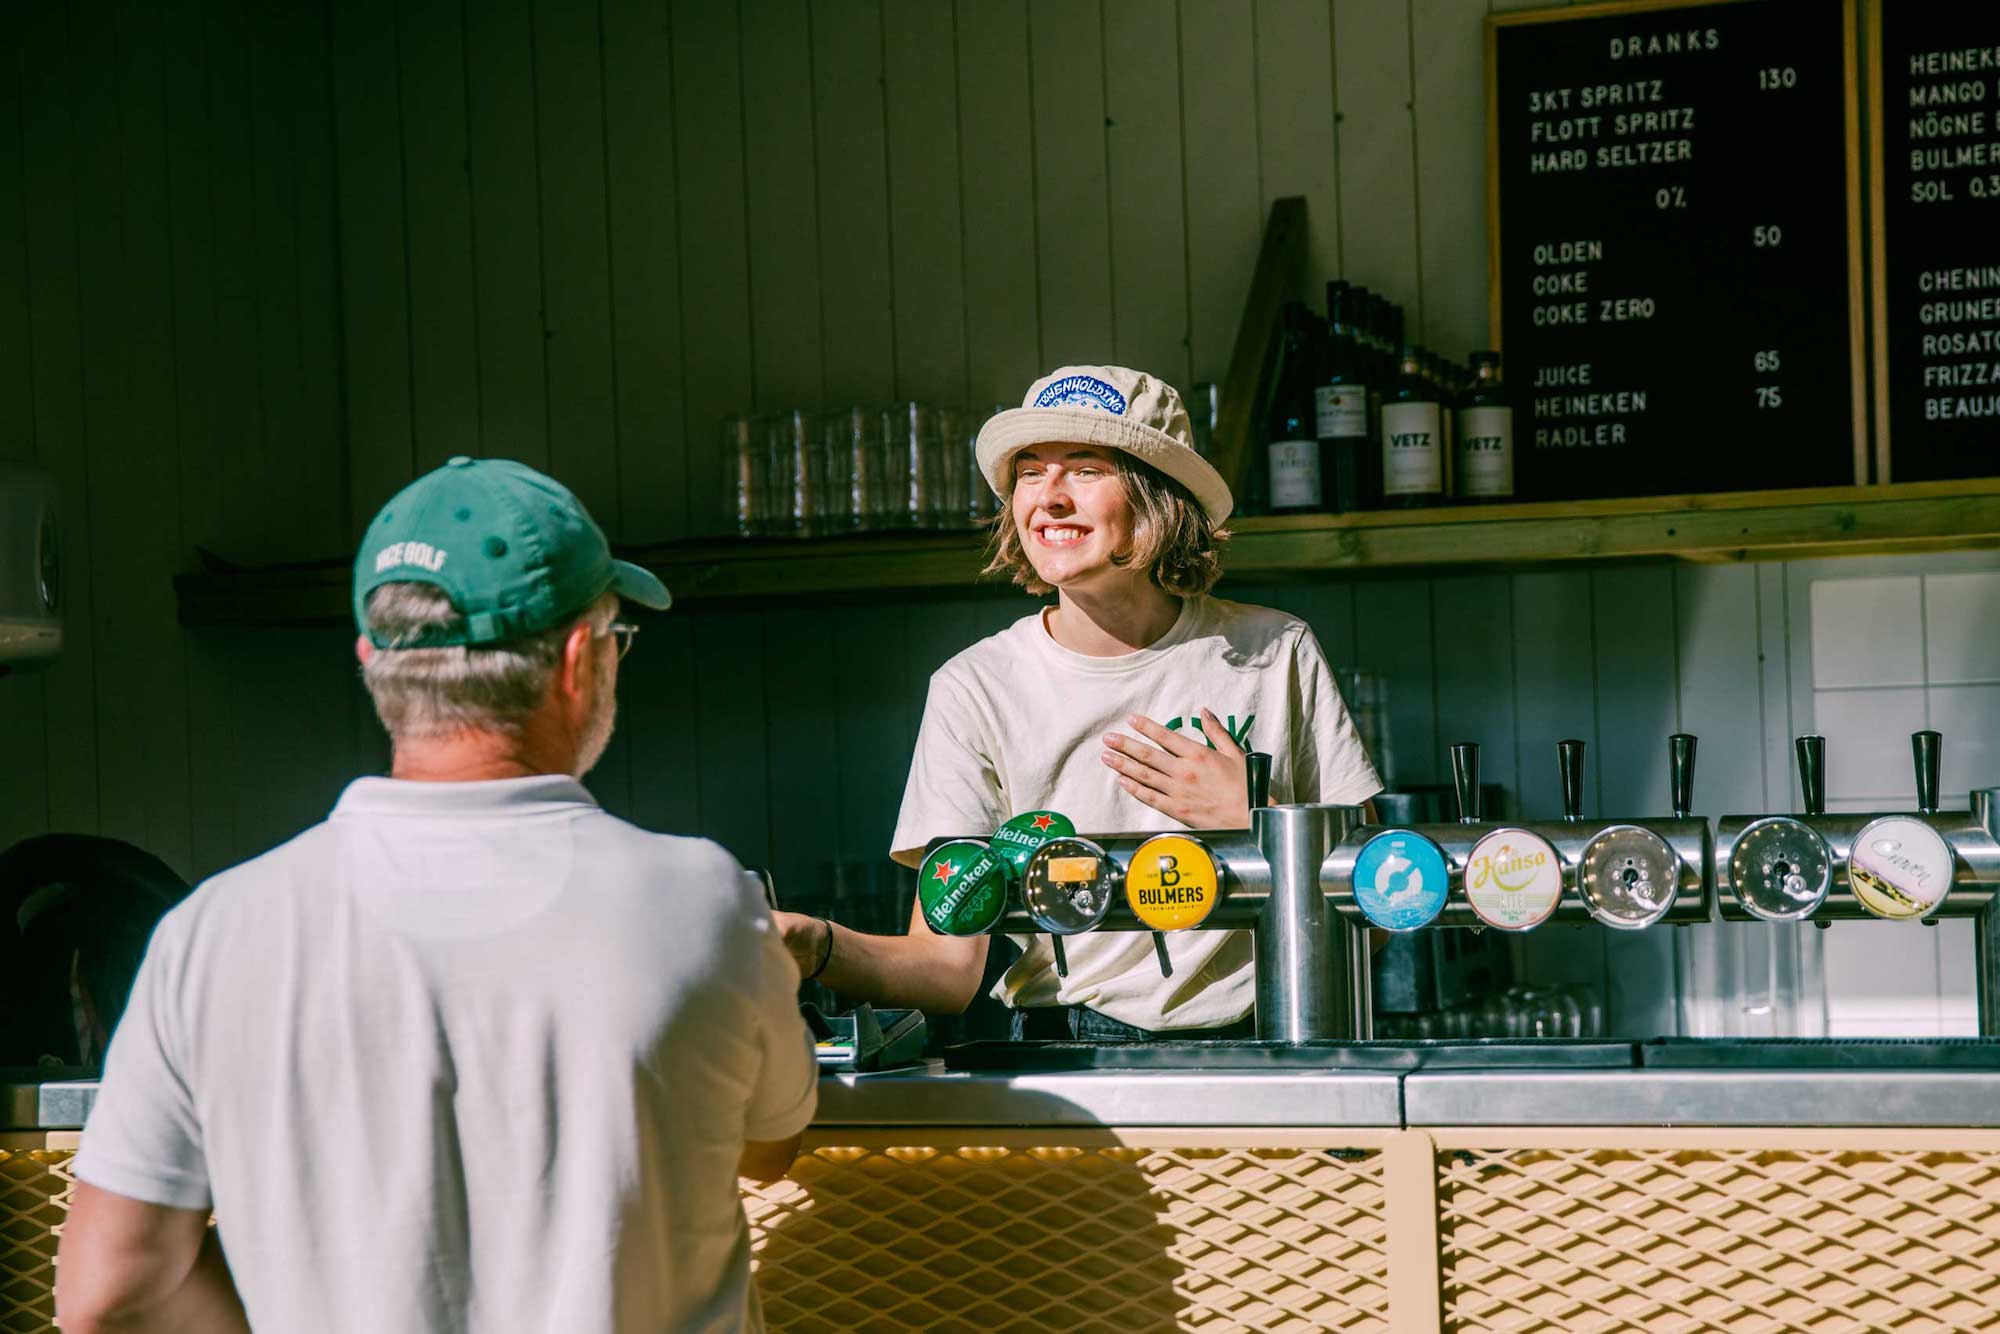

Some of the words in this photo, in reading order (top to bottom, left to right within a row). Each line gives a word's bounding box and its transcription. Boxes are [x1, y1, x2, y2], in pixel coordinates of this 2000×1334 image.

[1611, 29, 1719, 59] DRANKS
[1760, 67, 1796, 89] 130
[1581, 80, 1662, 107] SPRITZ
[1910, 81, 1985, 106] MANGO
[1532, 117, 1601, 142] FLOTT
[1615, 108, 1693, 135] SPRITZ
[1532, 149, 1587, 172] HARD
[1597, 140, 1691, 167] SELTZER
[1656, 186, 1686, 209] 0%
[1912, 181, 1953, 202] SOL
[1754, 226, 1781, 247] 50
[1534, 241, 1602, 265] OLDEN
[1533, 272, 1587, 296] COKE
[1534, 303, 1587, 326] COKE
[1600, 298, 1655, 321] ZERO
[1755, 351, 1780, 372] 65
[1534, 364, 1591, 387] JUICE
[1536, 392, 1646, 416] HEINEKEN
[1756, 386, 1782, 408] 75
[1391, 433, 1431, 447] VETZ
[1465, 437, 1502, 450] VETZ
[1536, 424, 1625, 446] RADLER
[1473, 845, 1546, 891] Hansa
[931, 857, 993, 924] Heineken
[1139, 886, 1204, 904] BULMERS
